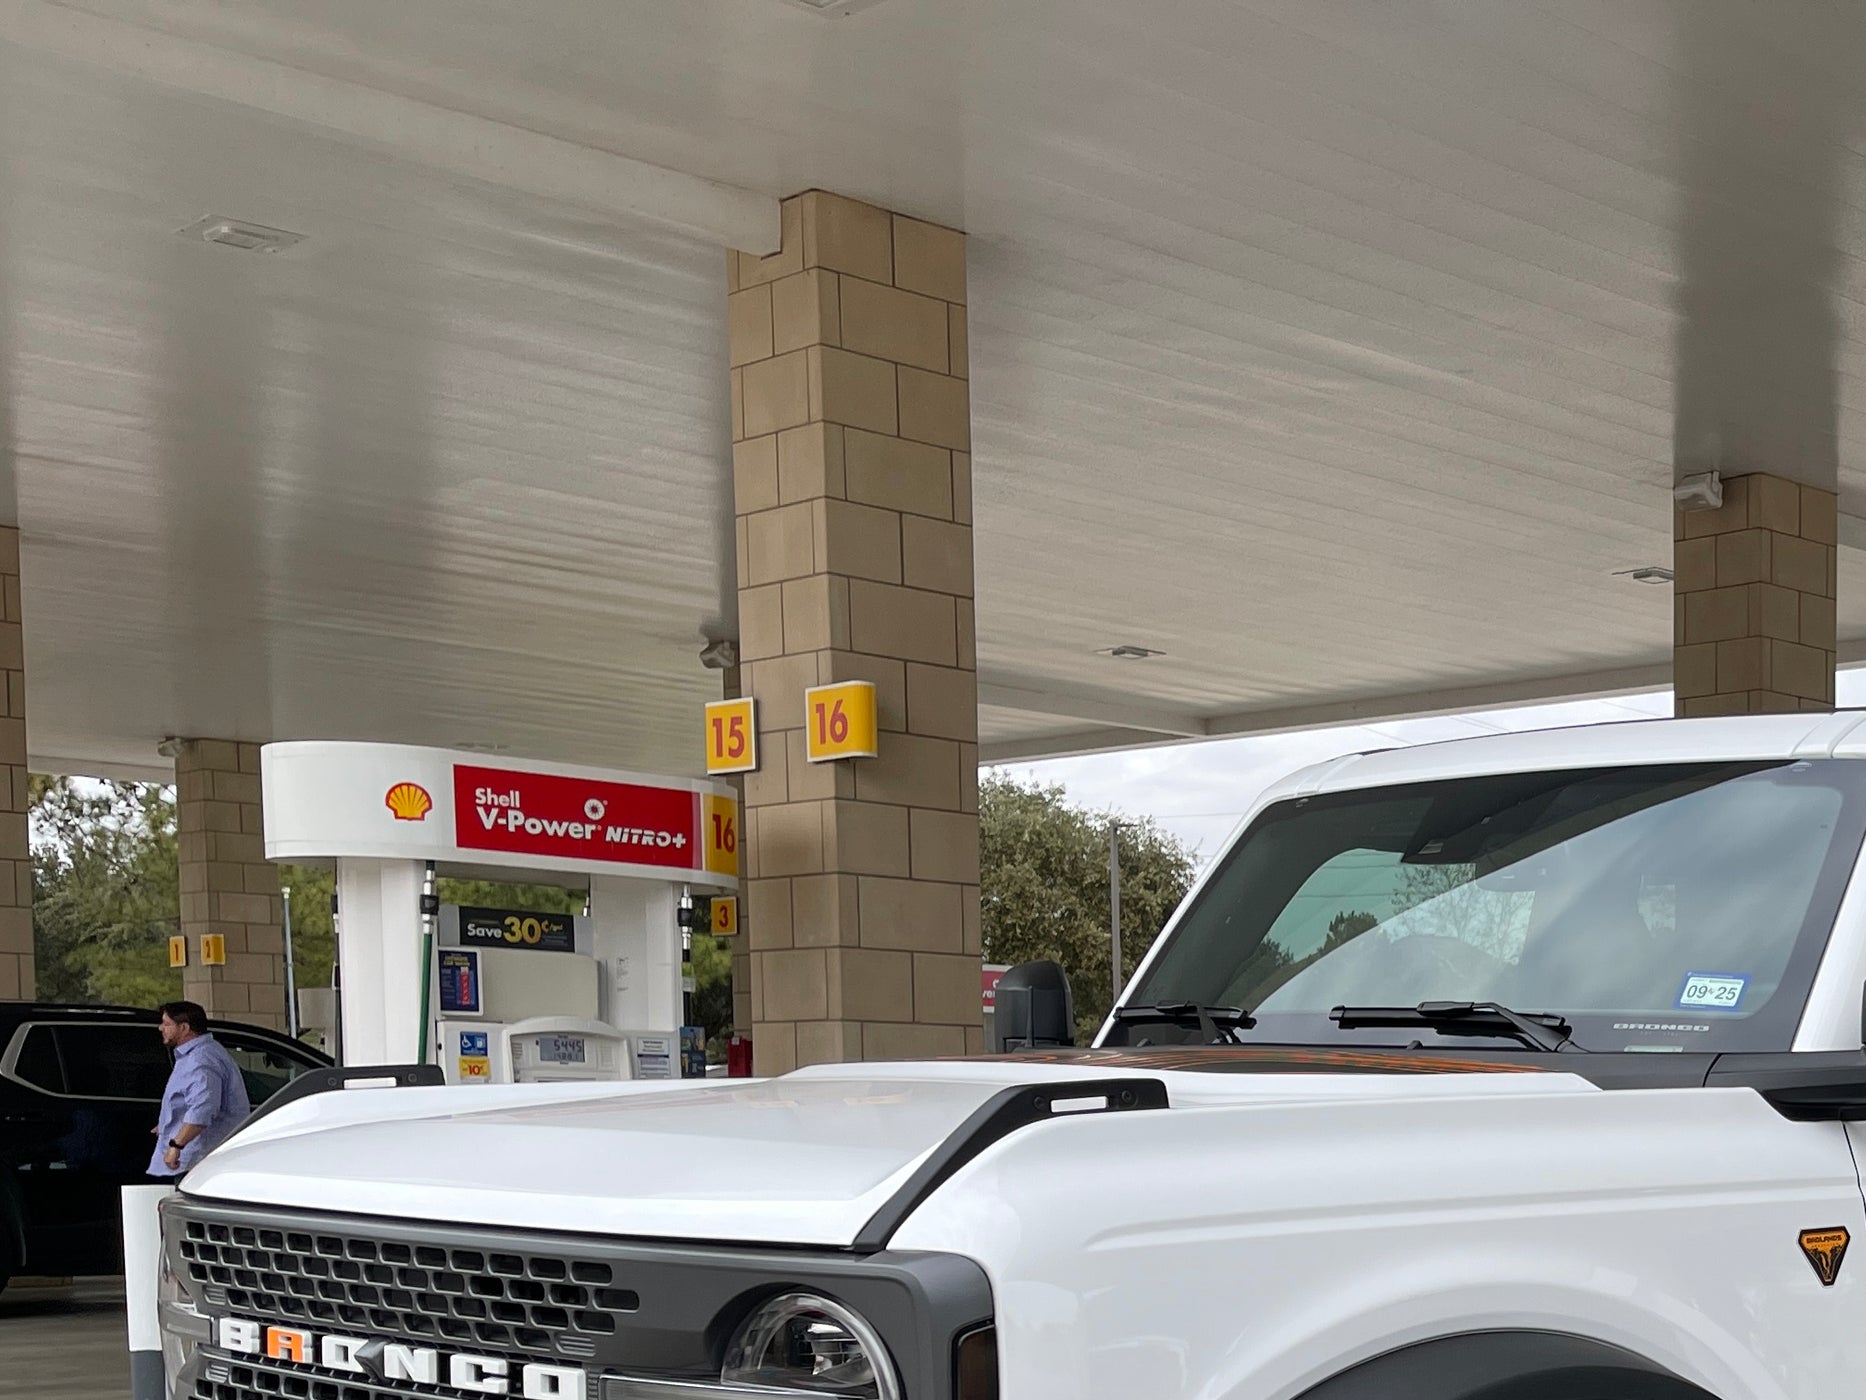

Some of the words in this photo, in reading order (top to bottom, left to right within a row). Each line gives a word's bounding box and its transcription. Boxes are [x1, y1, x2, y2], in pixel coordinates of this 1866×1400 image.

[815, 698, 848, 745] 16
[712, 715, 745, 758] 15
[475, 787, 520, 808] Shell
[476, 805, 596, 840] V-Power
[712, 814, 736, 853] 16
[467, 923, 502, 938] Save
[719, 905, 729, 928] 3
[1687, 985, 1708, 999] 09
[1714, 986, 1738, 1001] 25
